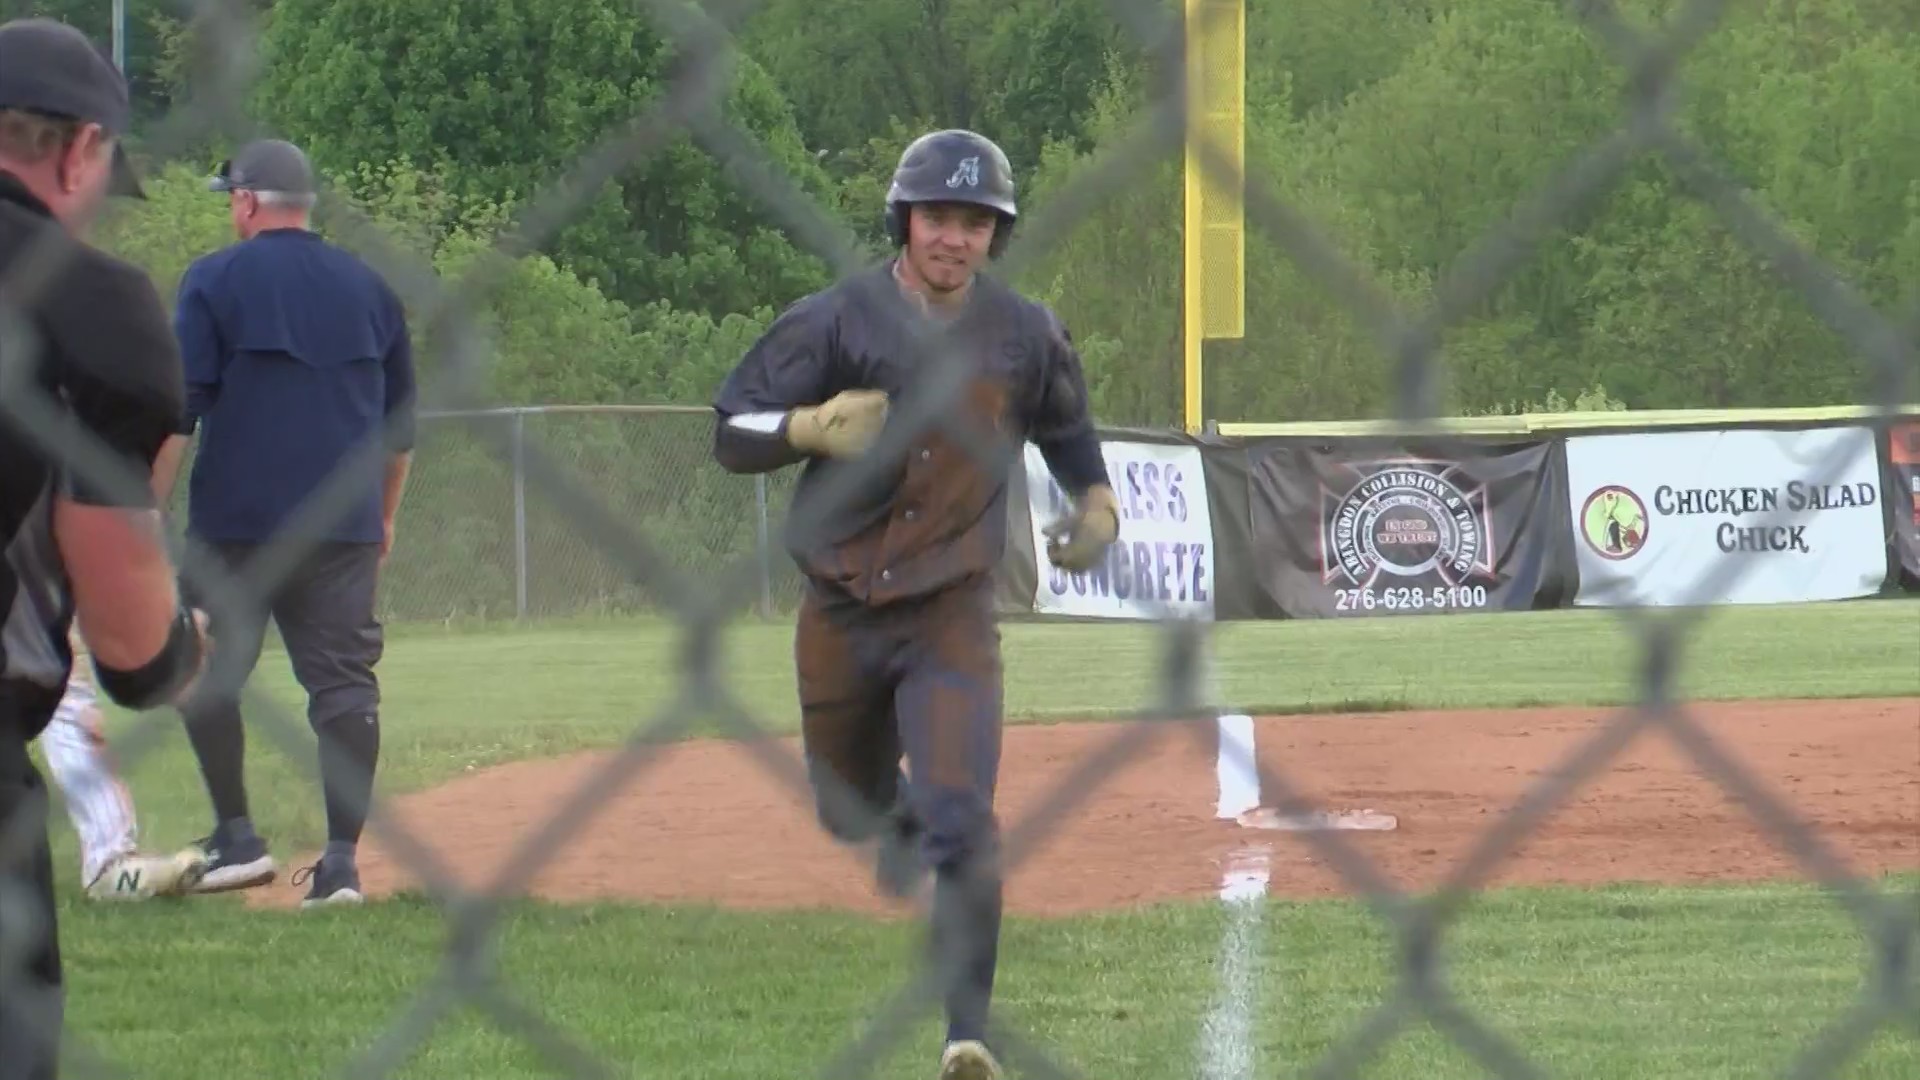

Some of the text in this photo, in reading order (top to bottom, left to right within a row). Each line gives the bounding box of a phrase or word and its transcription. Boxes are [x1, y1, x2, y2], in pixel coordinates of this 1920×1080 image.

[1361, 472, 1449, 500] COLLISION
[1446, 496, 1461, 509] &
[1454, 509, 1477, 573] TOWING
[1334, 585, 1487, 610] 276-628-5100
[117, 869, 140, 891] N
